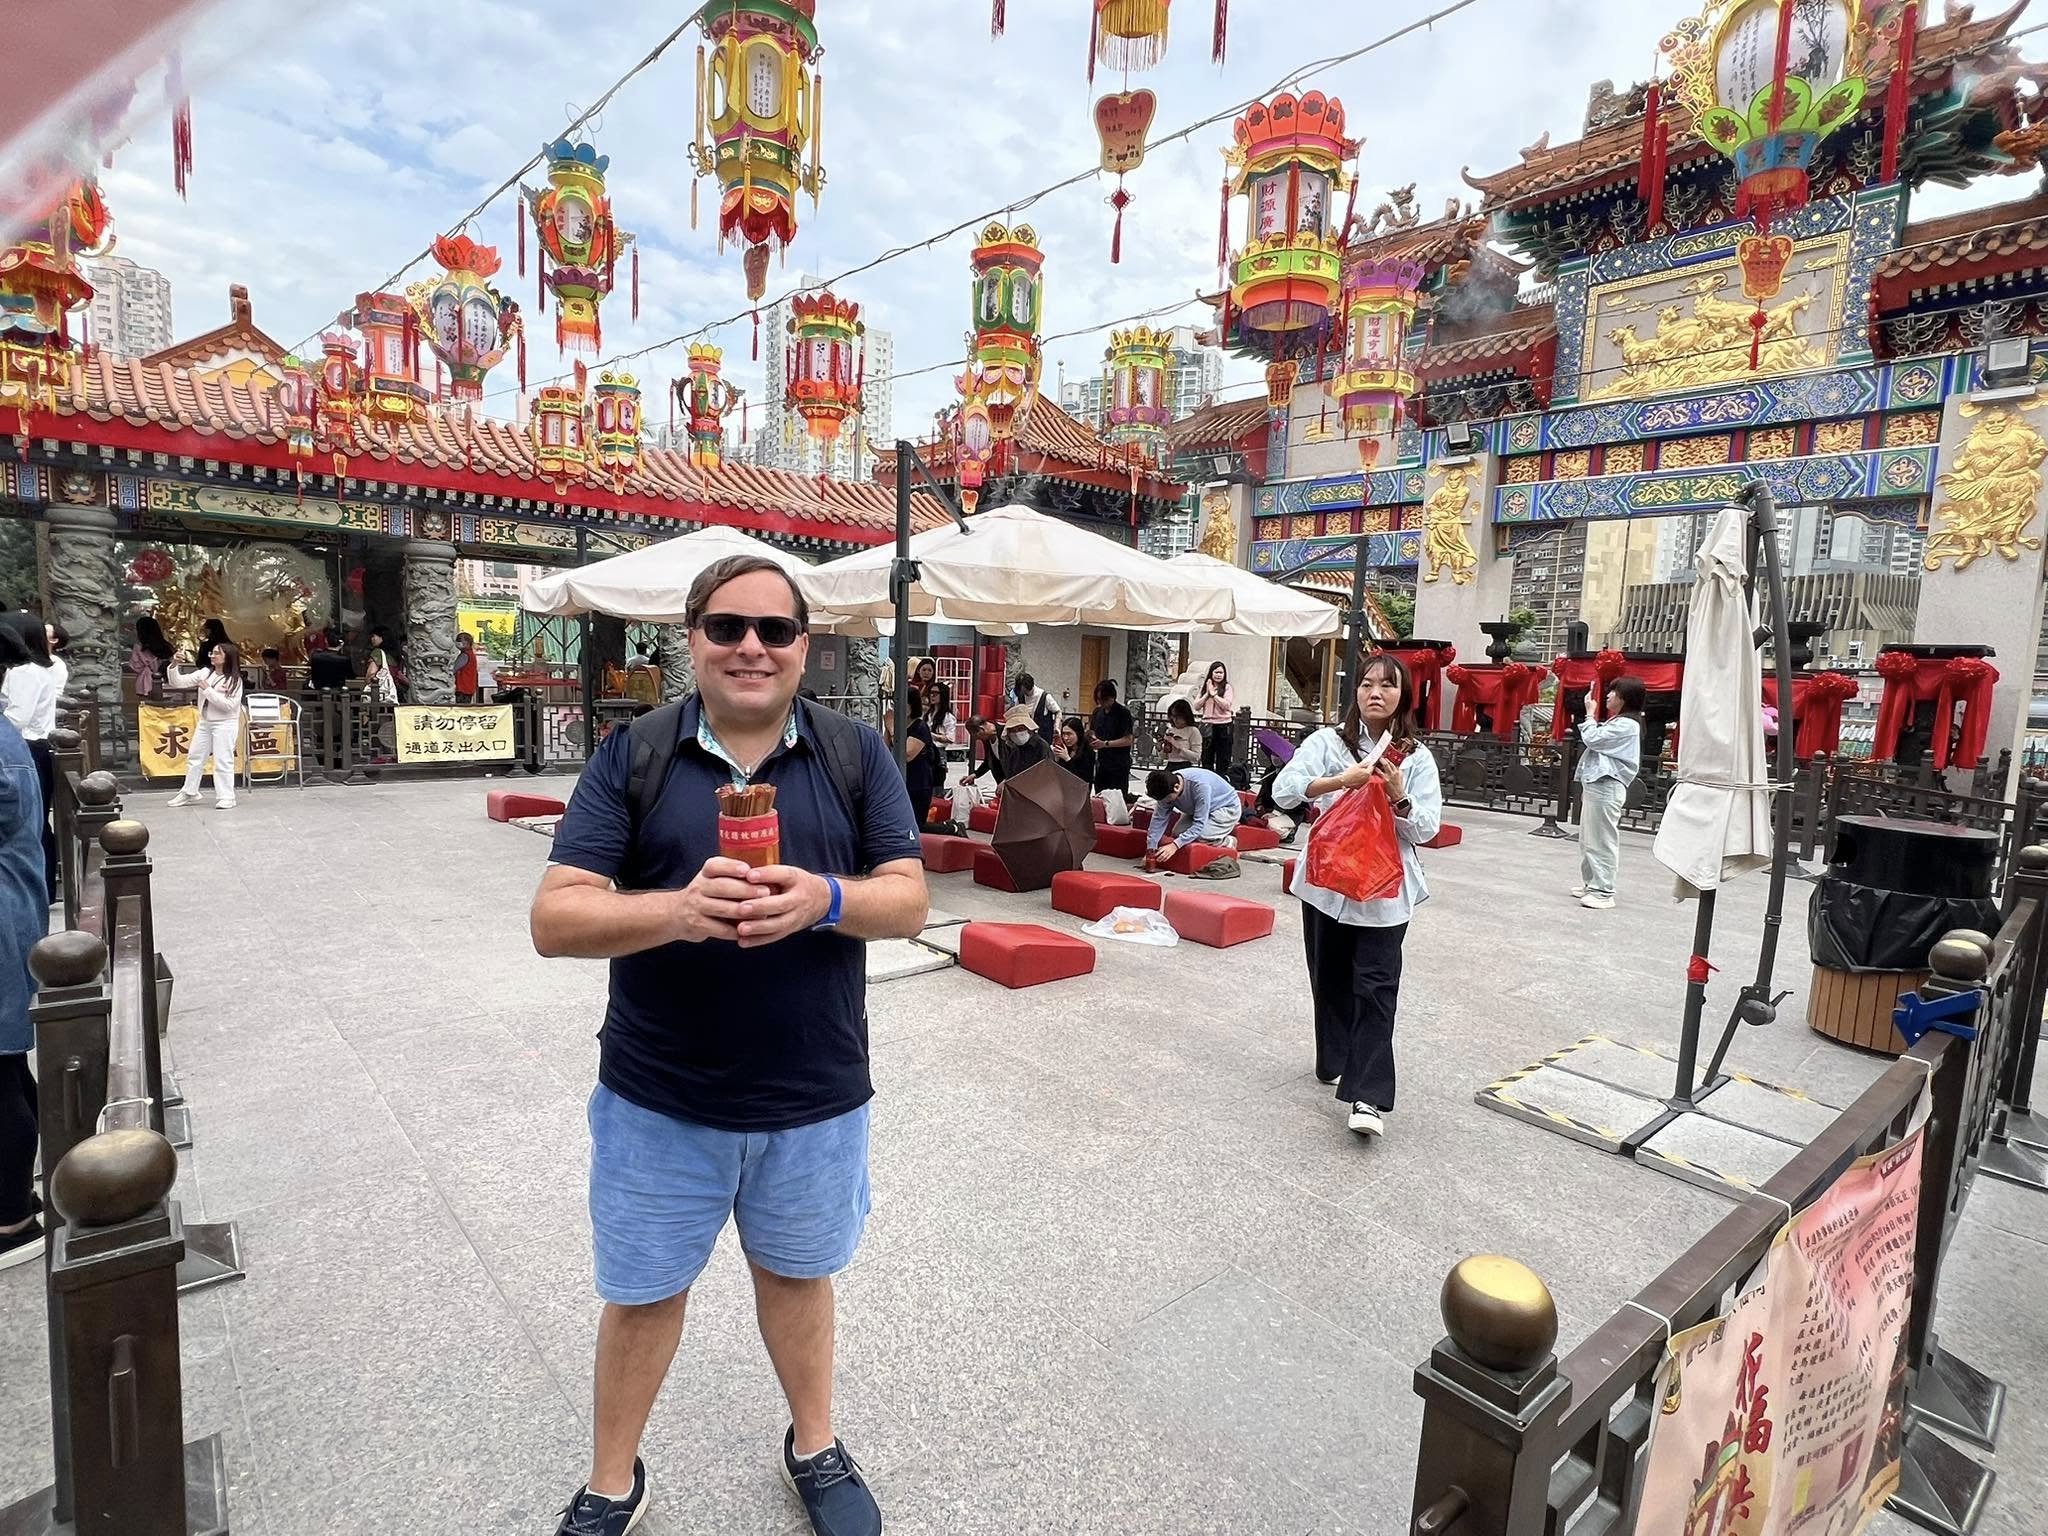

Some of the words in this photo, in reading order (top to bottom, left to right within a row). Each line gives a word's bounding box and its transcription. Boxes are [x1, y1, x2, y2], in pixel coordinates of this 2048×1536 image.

[413, 714, 498, 731] 請勿停留
[153, 725, 281, 759] 求區
[405, 740, 507, 755] 通道及出入口
